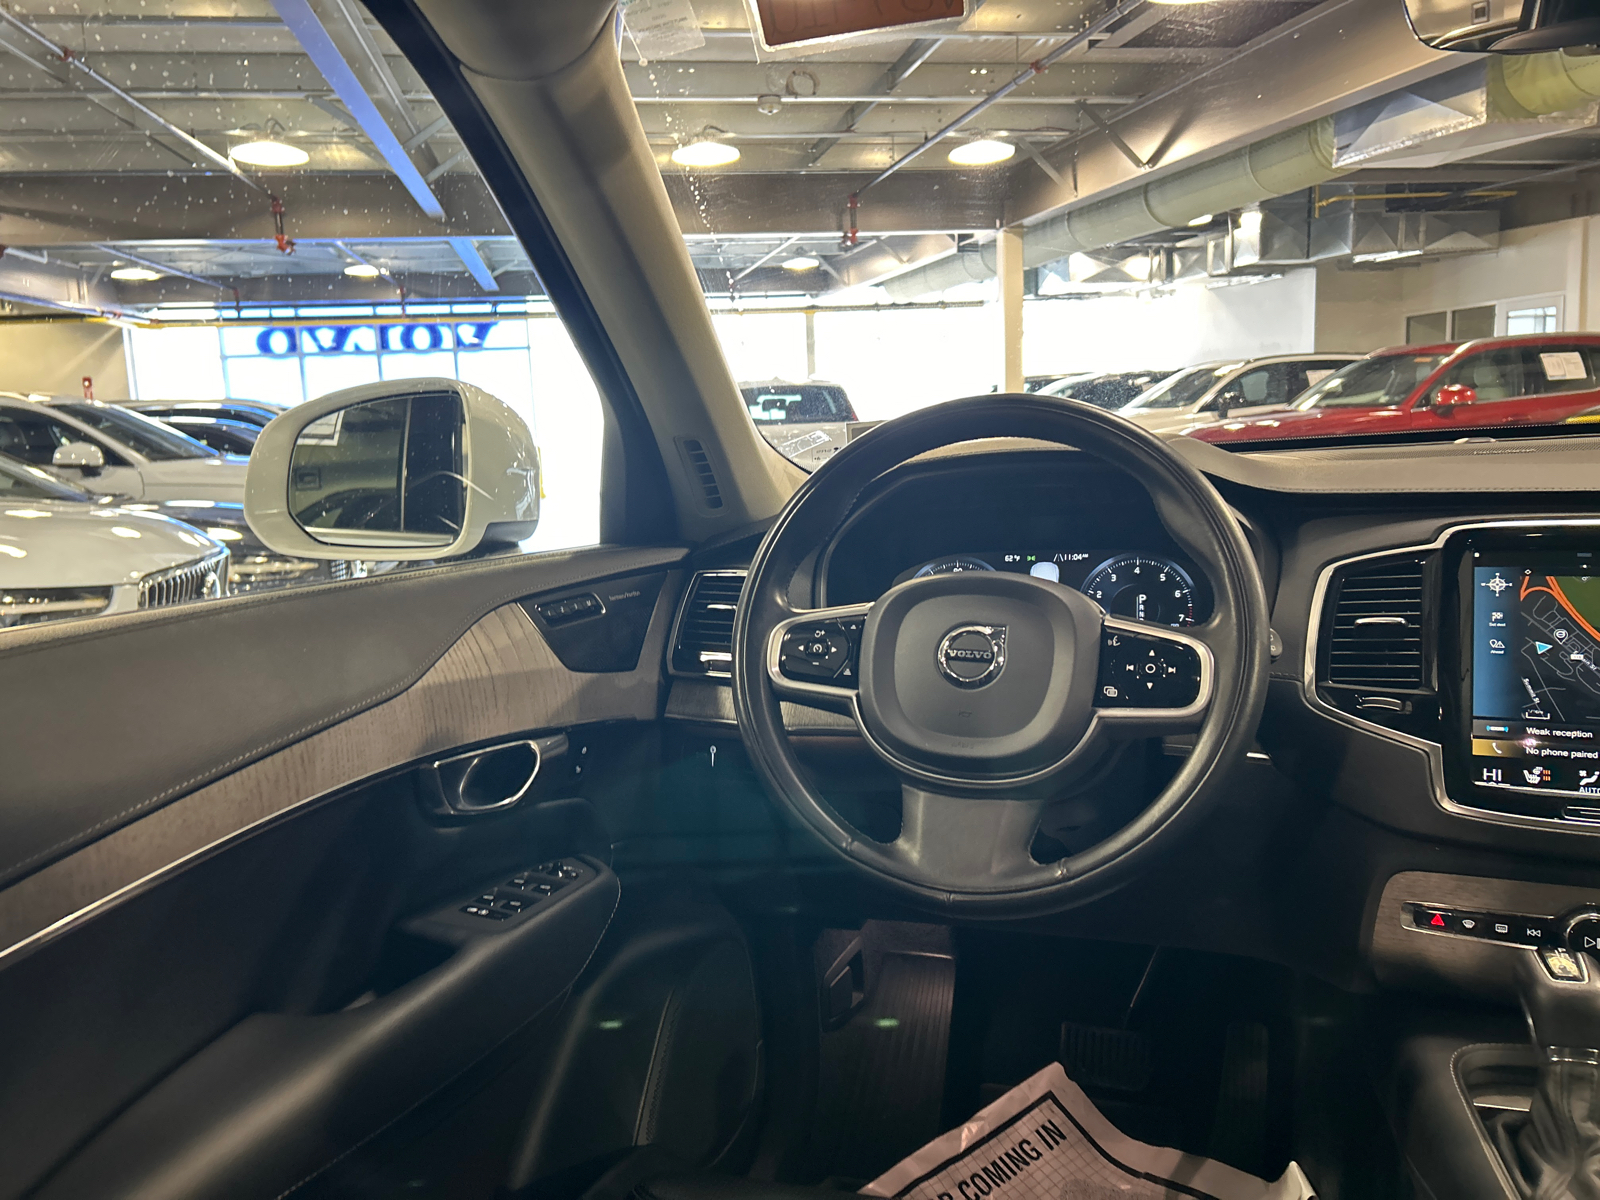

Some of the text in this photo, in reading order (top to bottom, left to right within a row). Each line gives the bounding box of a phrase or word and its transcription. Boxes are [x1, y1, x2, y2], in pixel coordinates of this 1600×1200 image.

[1134, 566, 1140, 575] 4
[1110, 573, 1117, 582] 3
[1159, 573, 1166, 582] 5
[1096, 590, 1103, 599] 2
[1174, 590, 1182, 598] 6
[1138, 594, 1147, 604] P
[1178, 614, 1185, 622] 7
[948, 649, 992, 659] VOLVO
[1526, 726, 1593, 739] Weak reception
[1525, 747, 1599, 759] No phone paired
[1483, 768, 1502, 782] HI
[957, 1119, 1068, 1200] COMING IN
